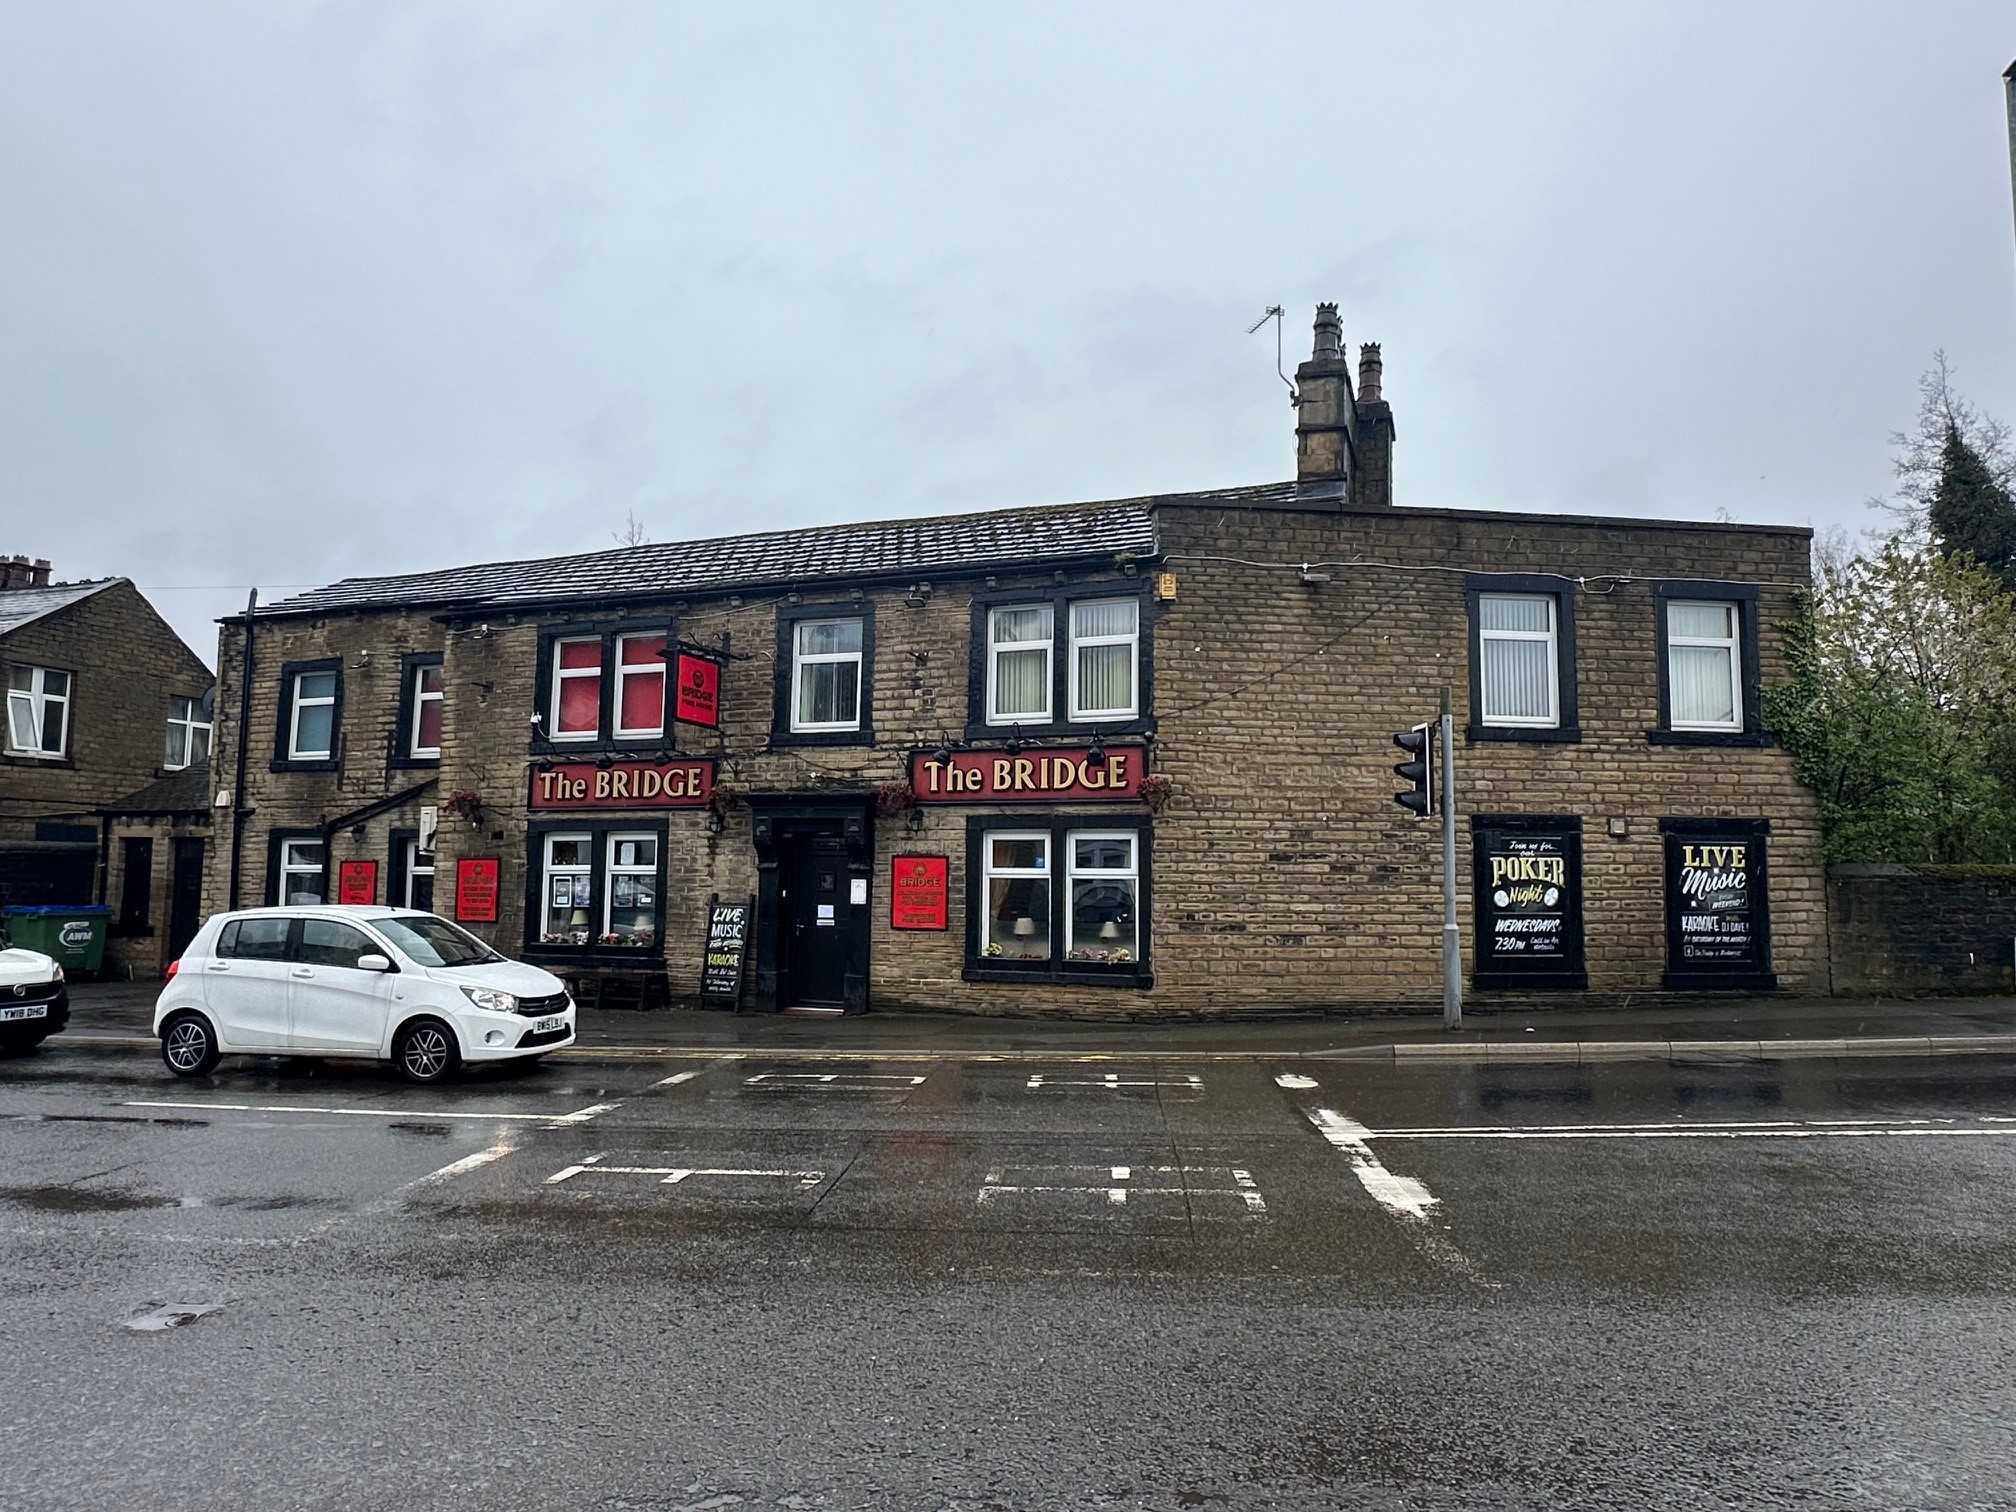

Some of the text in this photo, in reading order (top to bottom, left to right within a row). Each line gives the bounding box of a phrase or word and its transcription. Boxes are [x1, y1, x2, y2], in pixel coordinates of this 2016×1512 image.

[924, 756, 1128, 792] The BRIDGE
[540, 768, 702, 799] The BRIDGE
[1509, 841, 1527, 850] Join
[1682, 846, 1746, 867] LIVE
[1490, 857, 1566, 888] POKER
[900, 877, 941, 887] BRIDGE
[1682, 867, 1747, 900] Music
[1509, 884, 1543, 907] Night
[713, 908, 744, 923] LIVE
[711, 923, 742, 938] MUSIC
[1495, 919, 1560, 932] WEDNESDAYS
[1682, 916, 1719, 932] KARAOKE
[1721, 922, 1730, 932] DJ
[66, 931, 93, 941] AWM
[708, 953, 739, 967] KARAOKE
